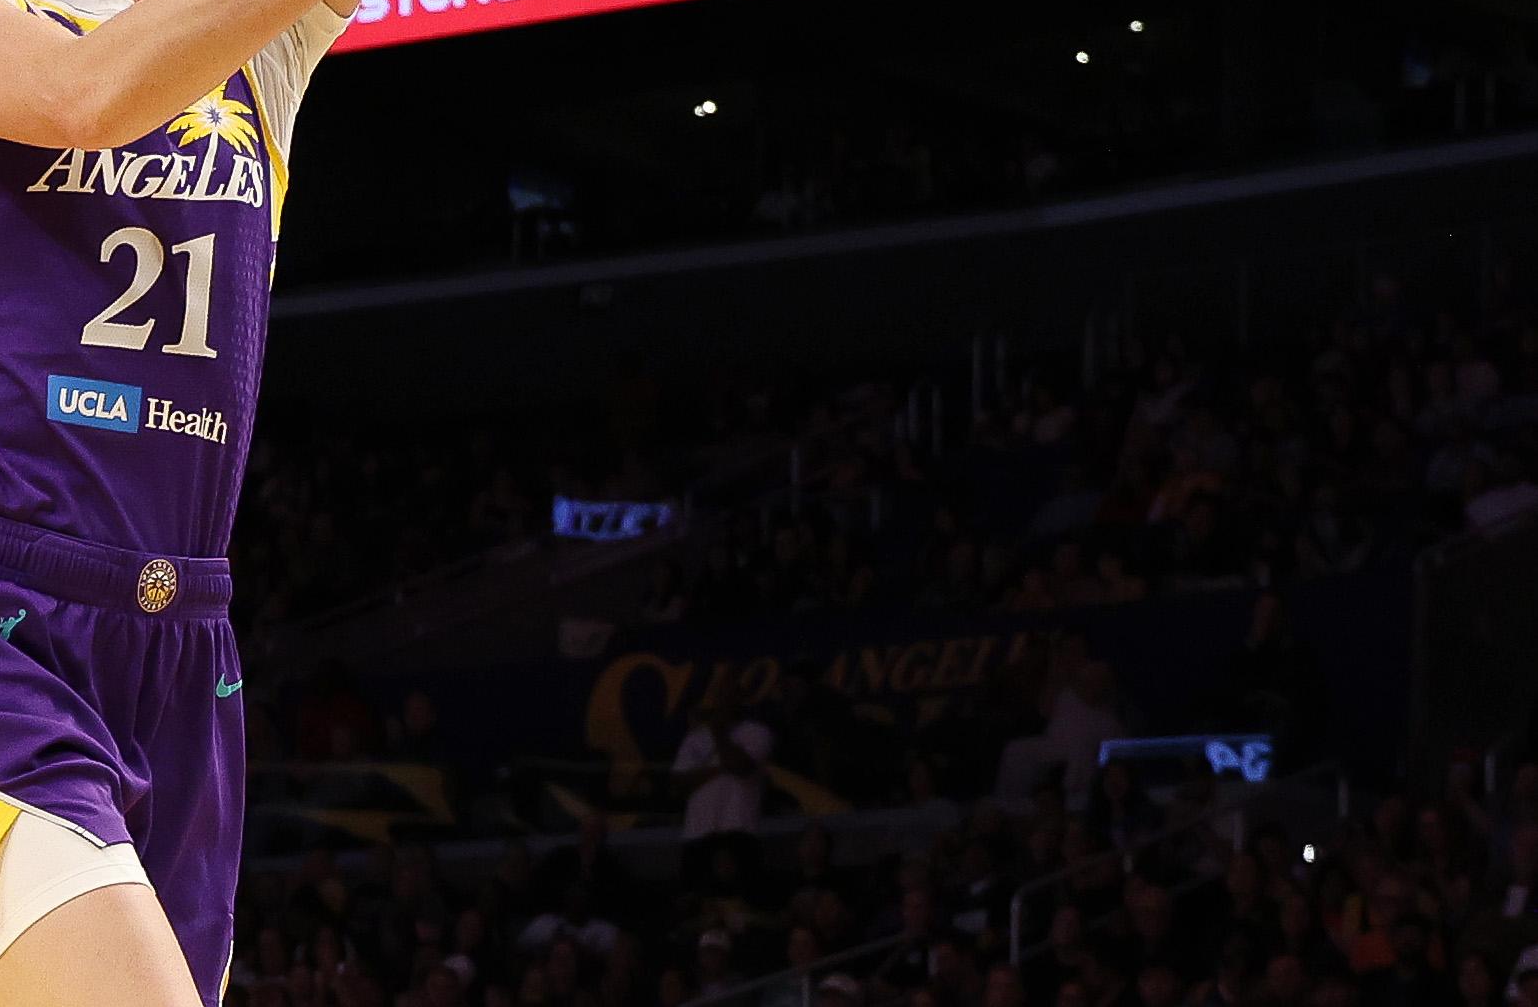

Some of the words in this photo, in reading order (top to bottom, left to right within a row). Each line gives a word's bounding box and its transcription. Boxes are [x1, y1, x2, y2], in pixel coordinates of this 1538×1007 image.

[26, 144, 265, 208] ANGELES
[80, 227, 218, 358] 21
[58, 388, 128, 422] UCLA
[145, 398, 228, 445] Health
